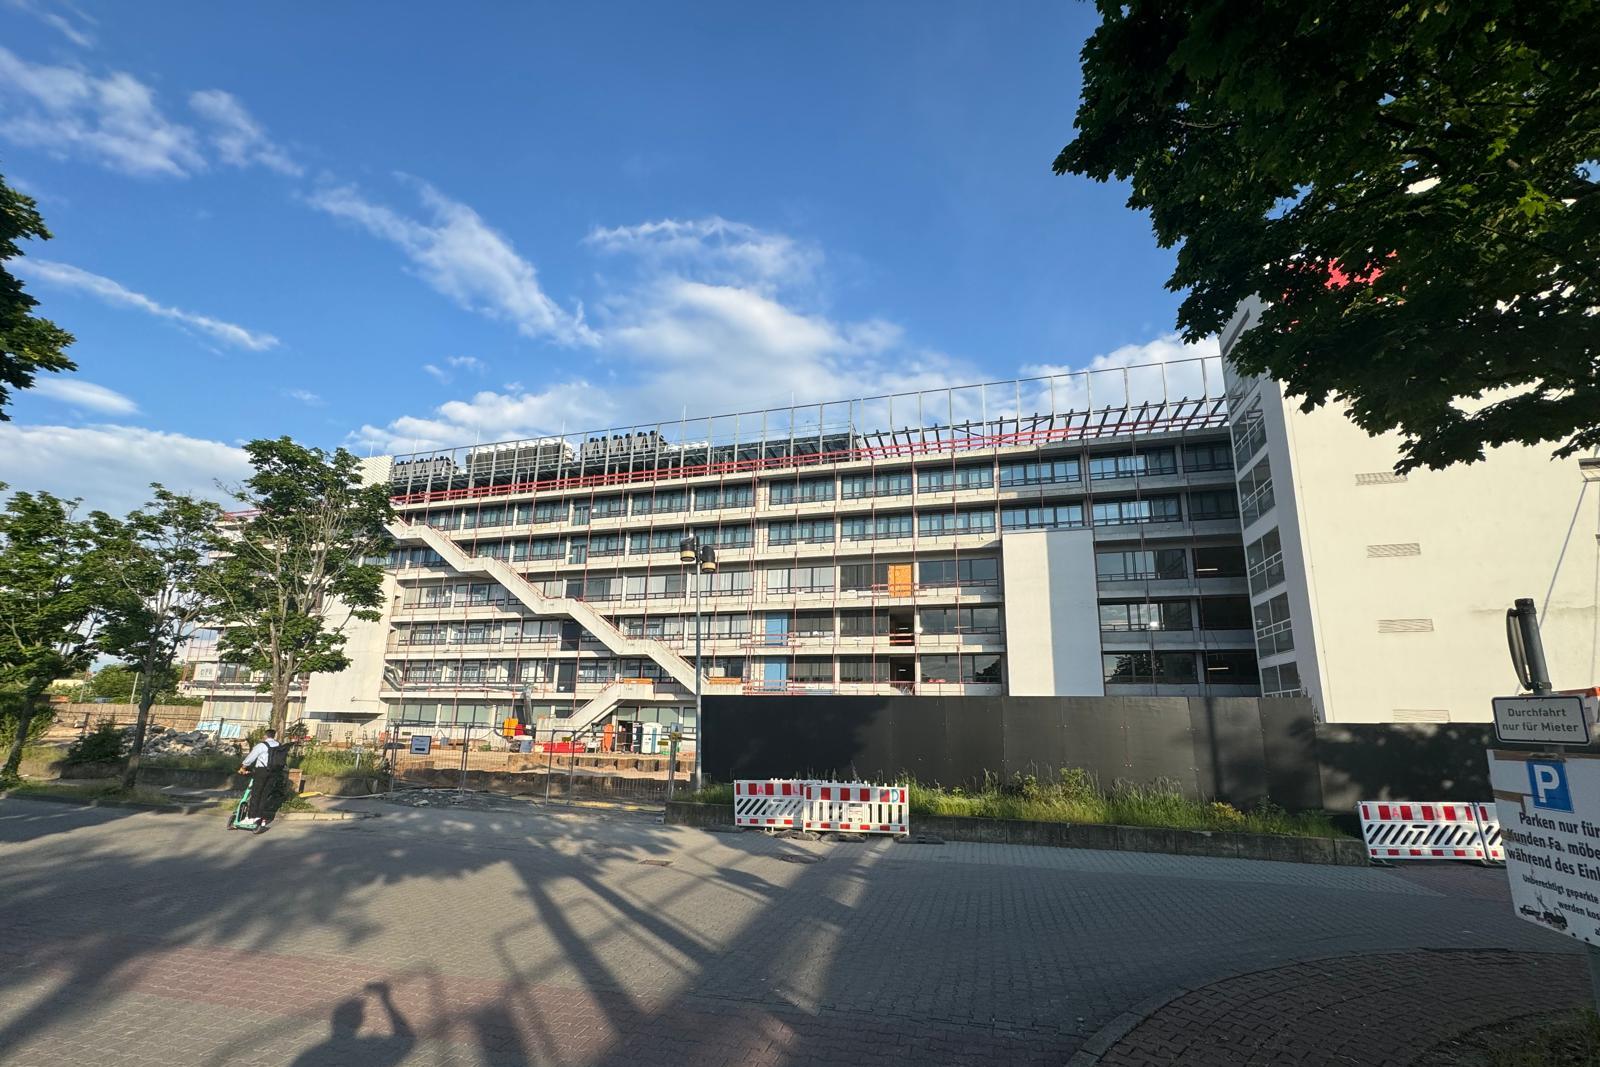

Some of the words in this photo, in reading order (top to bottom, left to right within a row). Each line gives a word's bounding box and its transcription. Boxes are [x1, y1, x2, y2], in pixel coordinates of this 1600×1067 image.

[1508, 708, 1567, 717] Durchfahrt
[1503, 723, 1519, 731] nur
[1523, 722, 1538, 731] für
[1541, 723, 1579, 732] Mieter
[1533, 764, 1560, 803] P
[1519, 812, 1556, 830] Parken
[1558, 822, 1579, 834] nur
[1581, 821, 1600, 838] für
[1547, 837, 1565, 852] Fa.
[1507, 848, 1552, 869] während
[1555, 857, 1575, 875] des
[1557, 901, 1585, 916] werden
